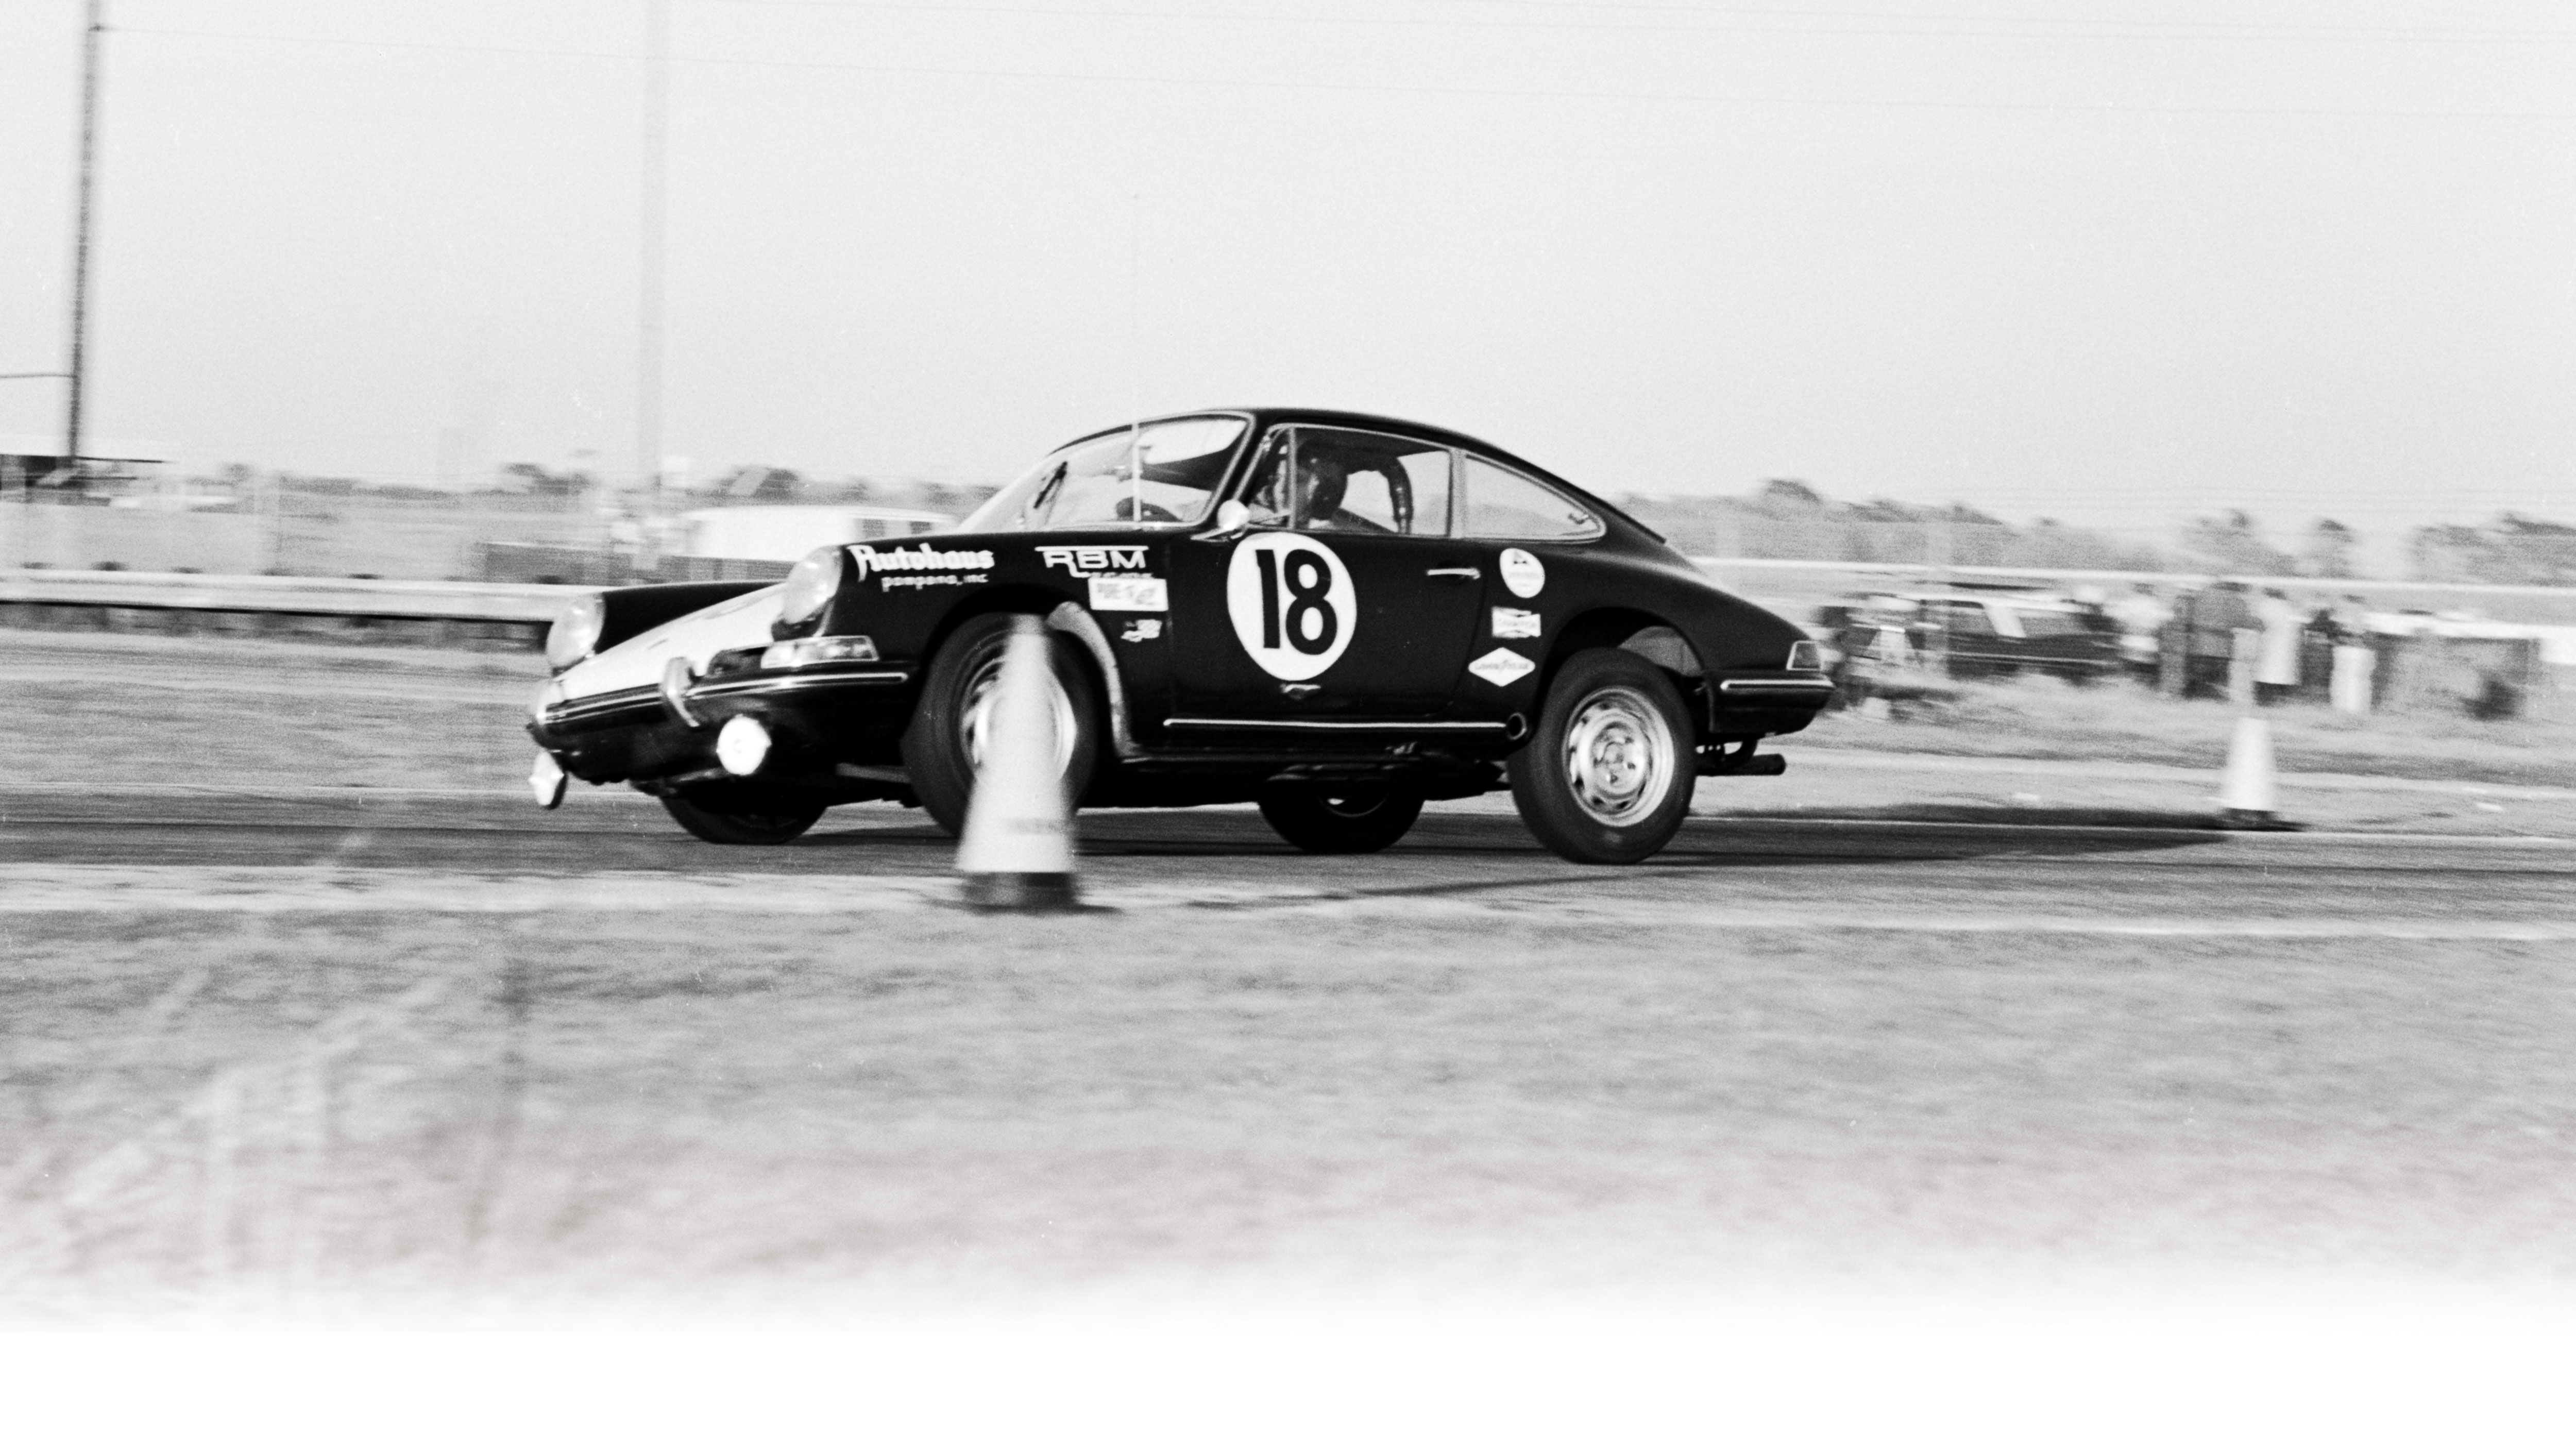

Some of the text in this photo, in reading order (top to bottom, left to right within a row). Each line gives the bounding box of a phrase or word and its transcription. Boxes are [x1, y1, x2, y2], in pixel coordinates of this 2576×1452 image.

[846, 543, 995, 582] Autohaus
[1038, 546, 1148, 578] RBM
[1256, 549, 1337, 655] 18
